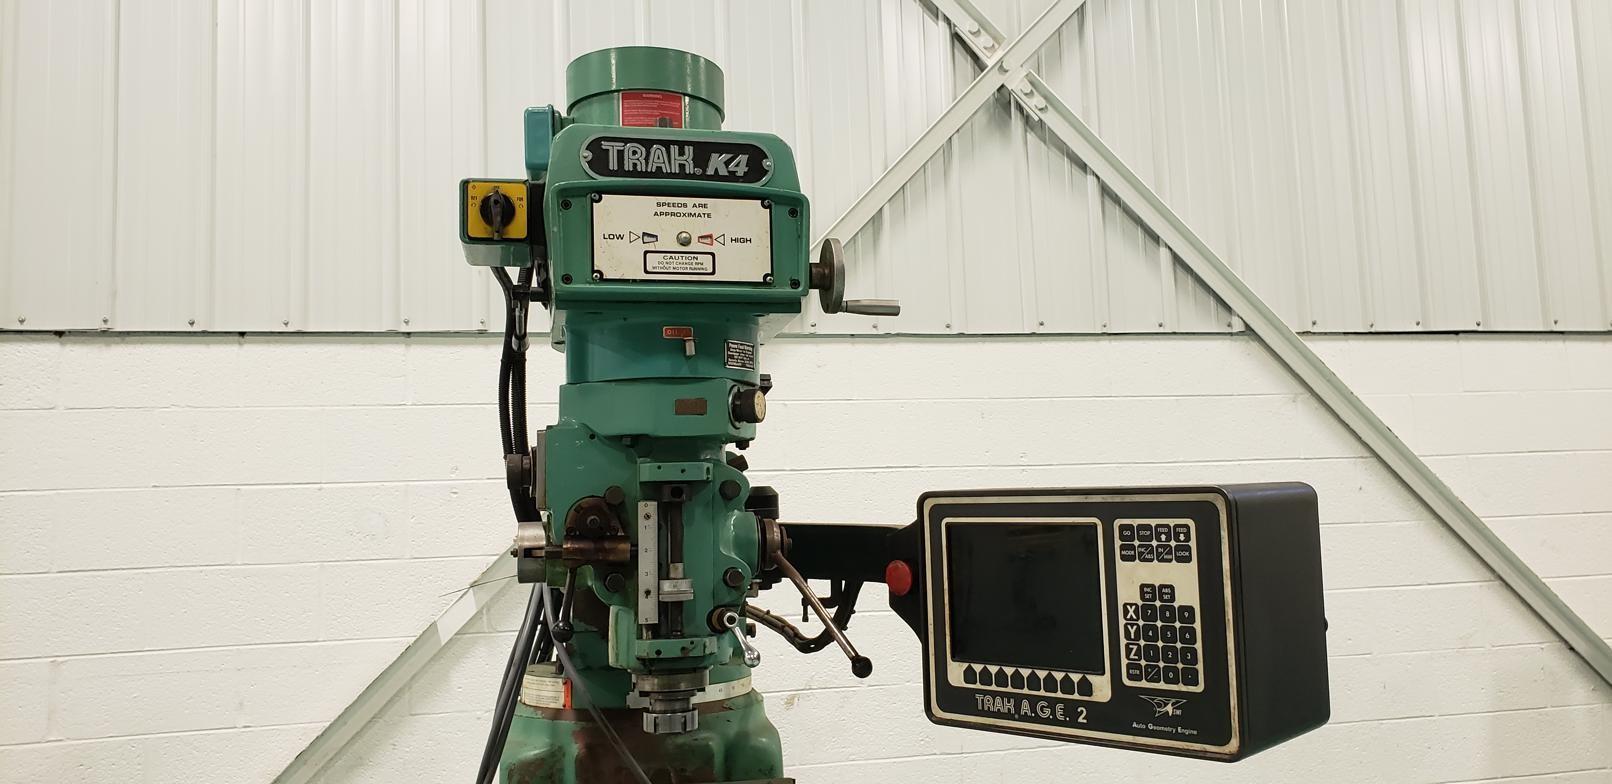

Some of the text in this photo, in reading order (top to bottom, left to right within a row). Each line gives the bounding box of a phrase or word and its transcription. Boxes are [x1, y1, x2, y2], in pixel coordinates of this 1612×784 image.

[601, 141, 749, 176] TRAK K4
[1126, 605, 1137, 619] X
[1127, 625, 1137, 639] Y
[1128, 645, 1138, 659] Z
[975, 694, 1088, 723] TRAK A.G.E. 2
[1148, 724, 1176, 733] Geometry
[1178, 727, 1198, 735] Engine
